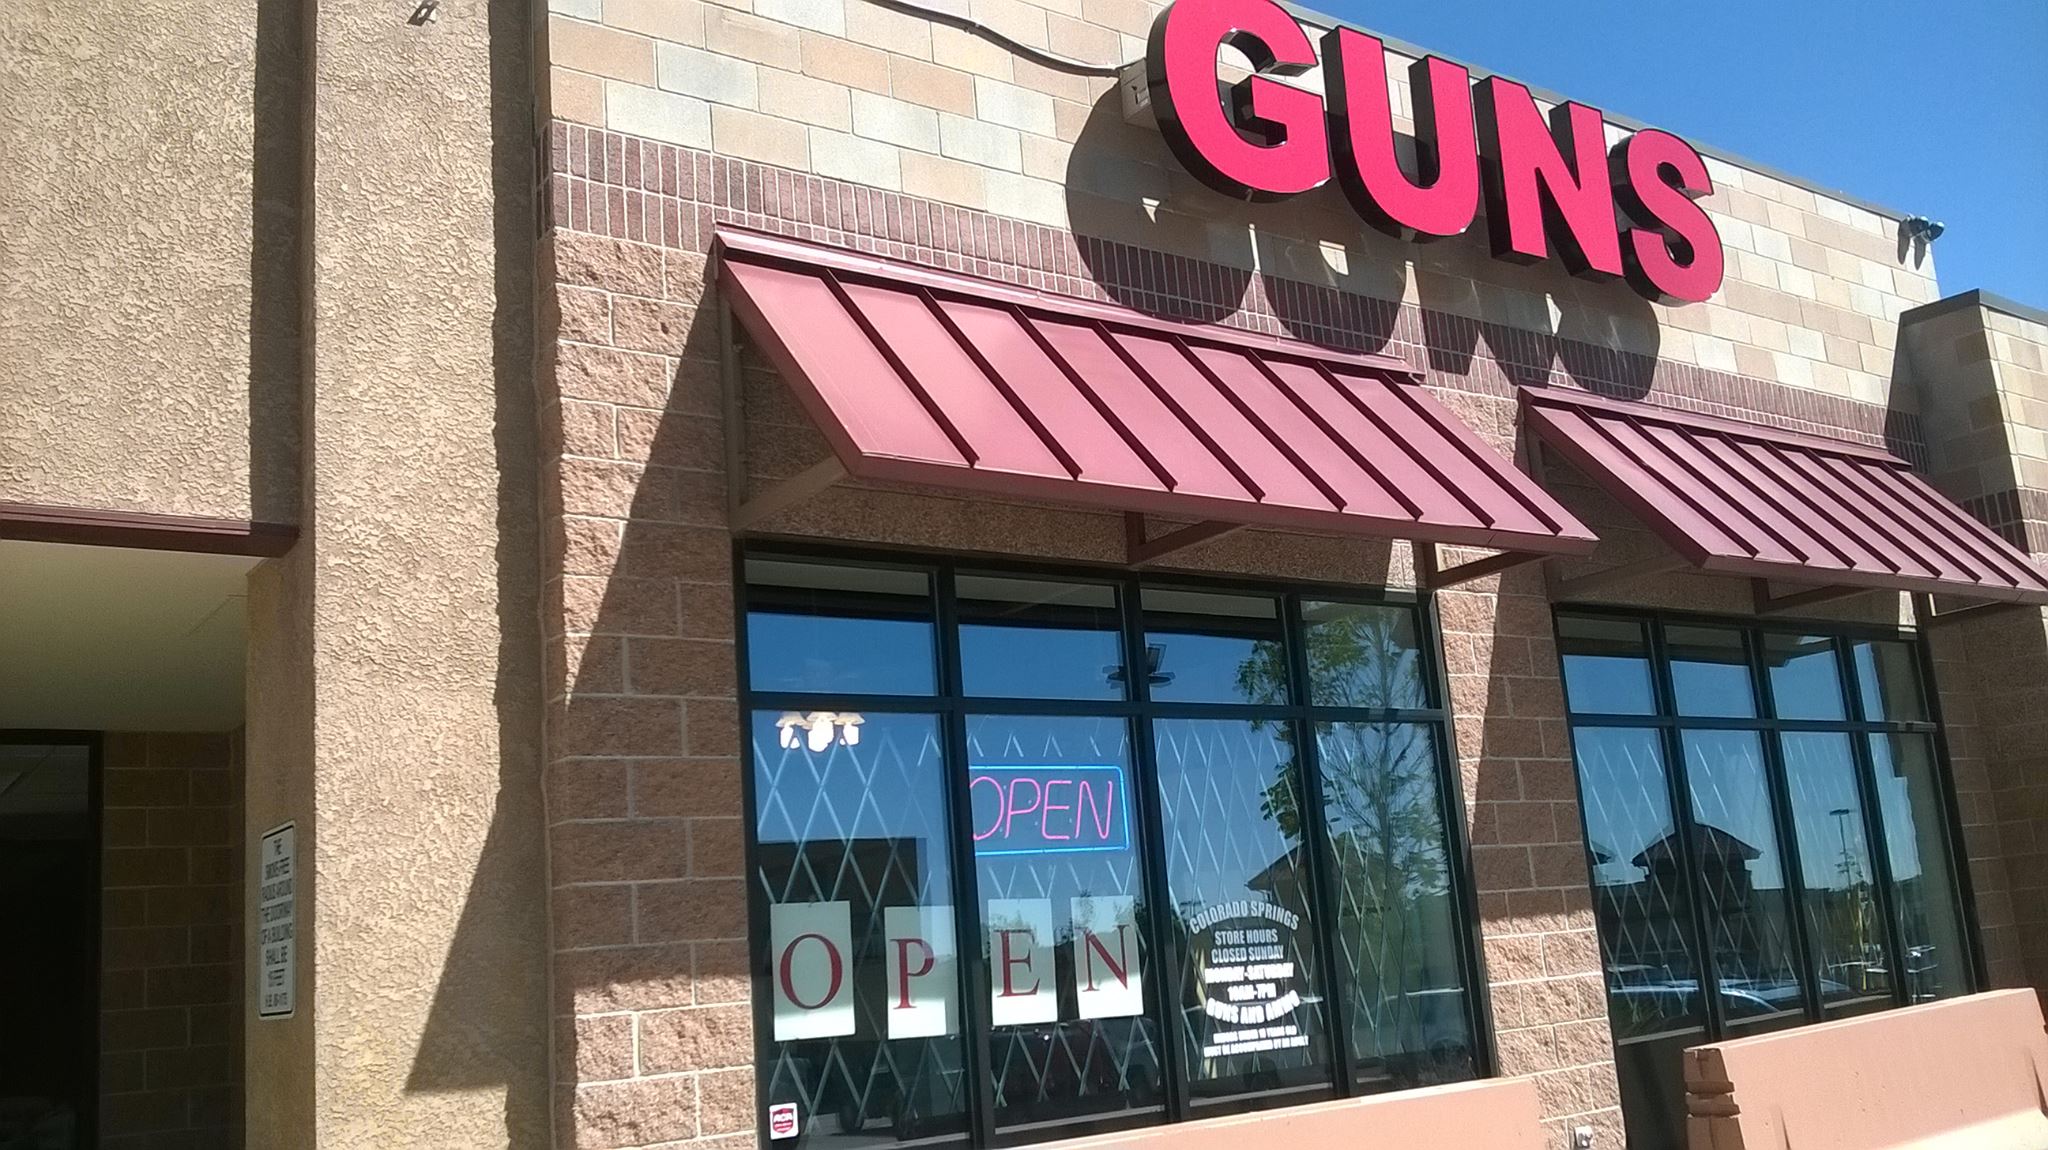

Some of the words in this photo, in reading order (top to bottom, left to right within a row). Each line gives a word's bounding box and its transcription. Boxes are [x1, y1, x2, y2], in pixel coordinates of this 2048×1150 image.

[1150, 0, 1724, 303] GUNS
[969, 775, 1113, 841] OPEN
[1189, 900, 1248, 934] COLORADO
[1250, 901, 1300, 931] SPRINGS
[1211, 947, 1246, 964] CLOSED
[1248, 945, 1284, 961] SUNDAY
[1214, 930, 1245, 946] STORE
[1246, 929, 1278, 944] HOURS
[780, 924, 1130, 1010] OPEN
[1206, 997, 1239, 1023] GUNS
[1240, 1005, 1265, 1024] AND
[1265, 989, 1300, 1021] AMMO
